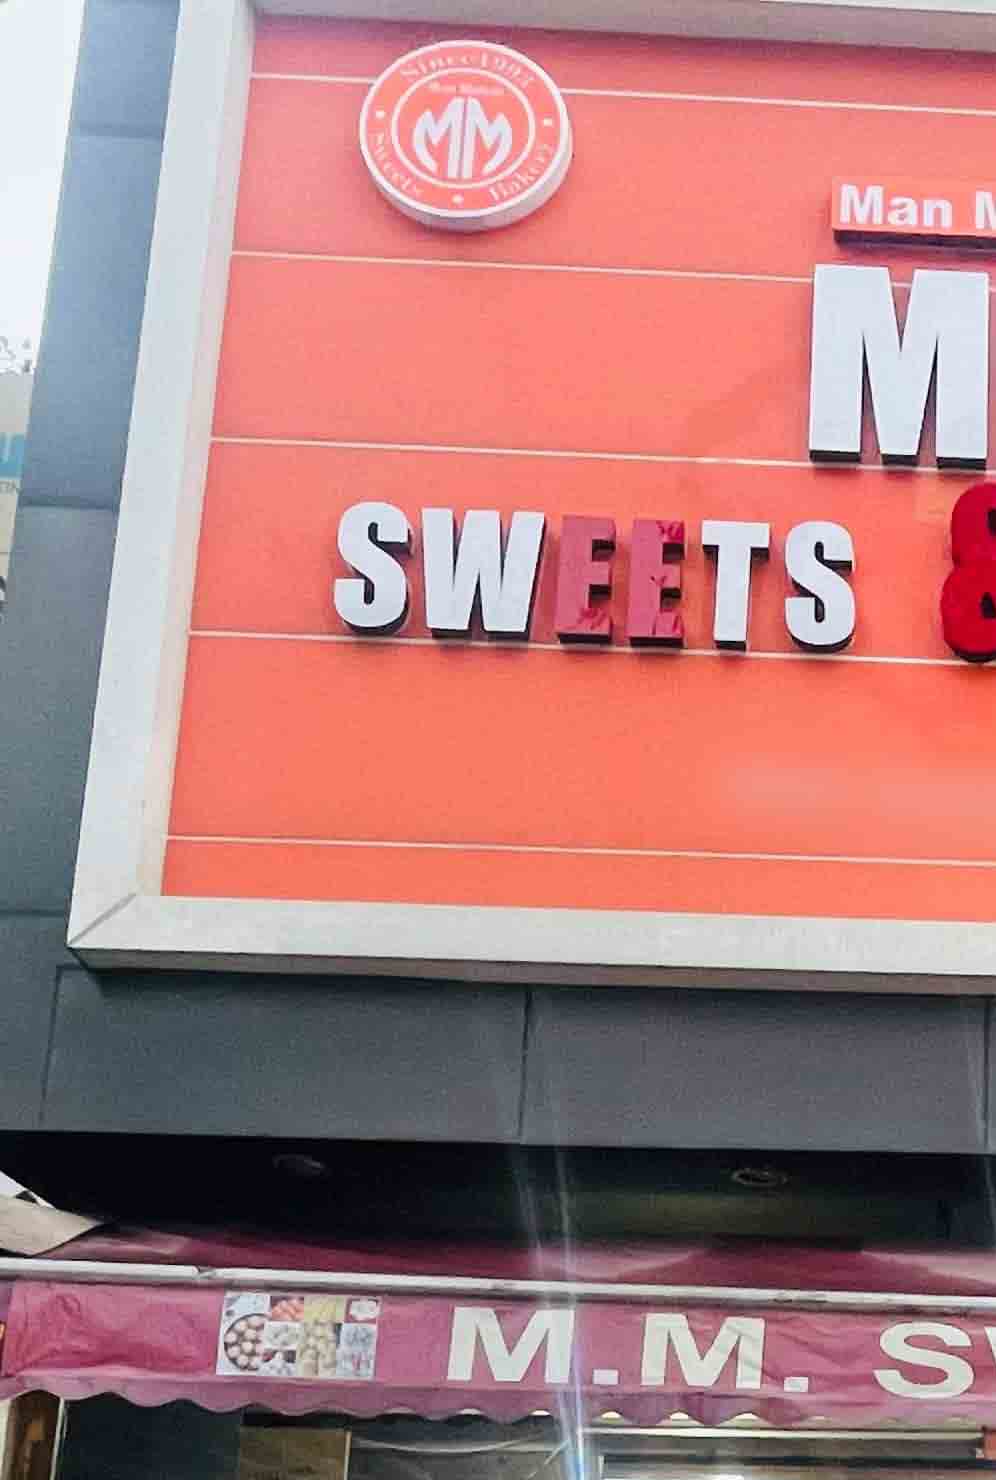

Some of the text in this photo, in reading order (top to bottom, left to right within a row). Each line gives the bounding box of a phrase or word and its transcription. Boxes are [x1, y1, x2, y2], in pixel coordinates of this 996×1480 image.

[839, 183, 953, 228] Man
[334, 501, 855, 652] SWEETS
[446, 1306, 809, 1393] M.M.
